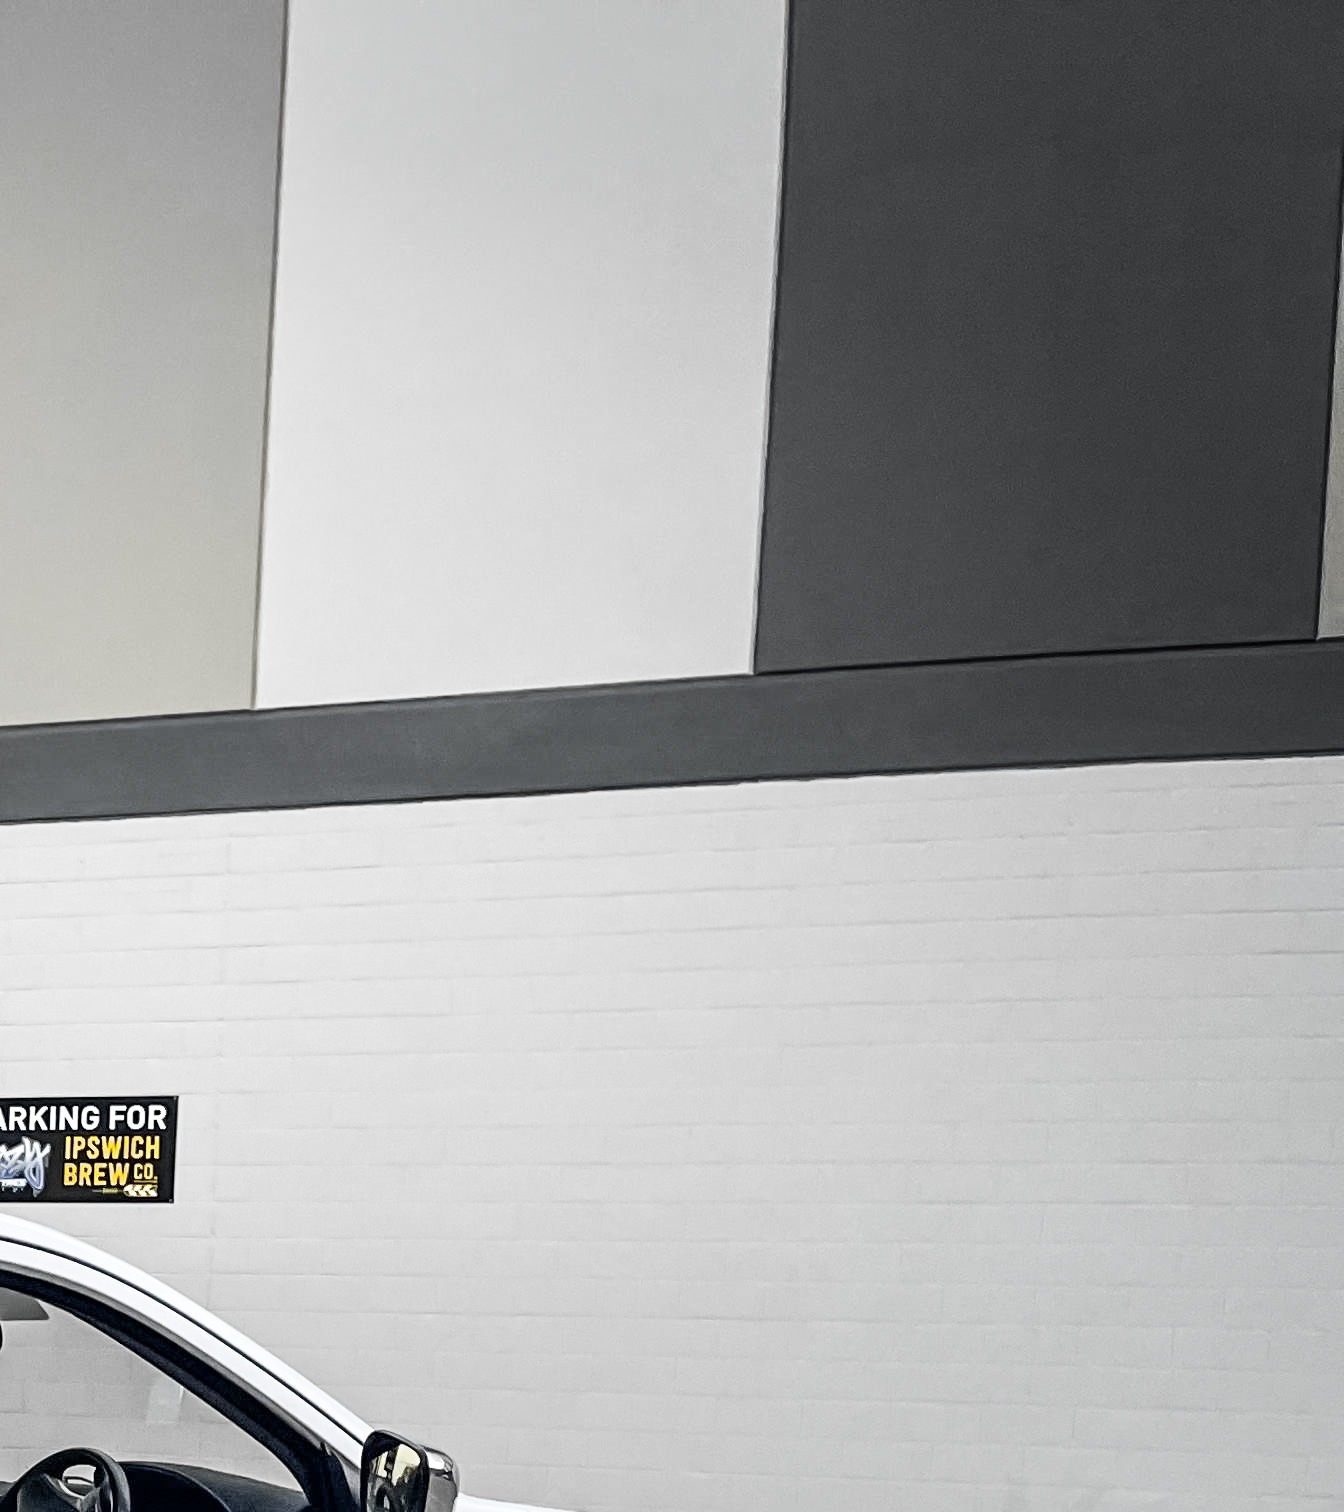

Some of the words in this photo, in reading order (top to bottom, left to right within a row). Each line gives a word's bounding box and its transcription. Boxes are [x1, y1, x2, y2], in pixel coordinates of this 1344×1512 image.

[108, 1104, 168, 1130] FOR
[64, 1135, 160, 1160] IPSWICH
[63, 1162, 130, 1186] BREW
